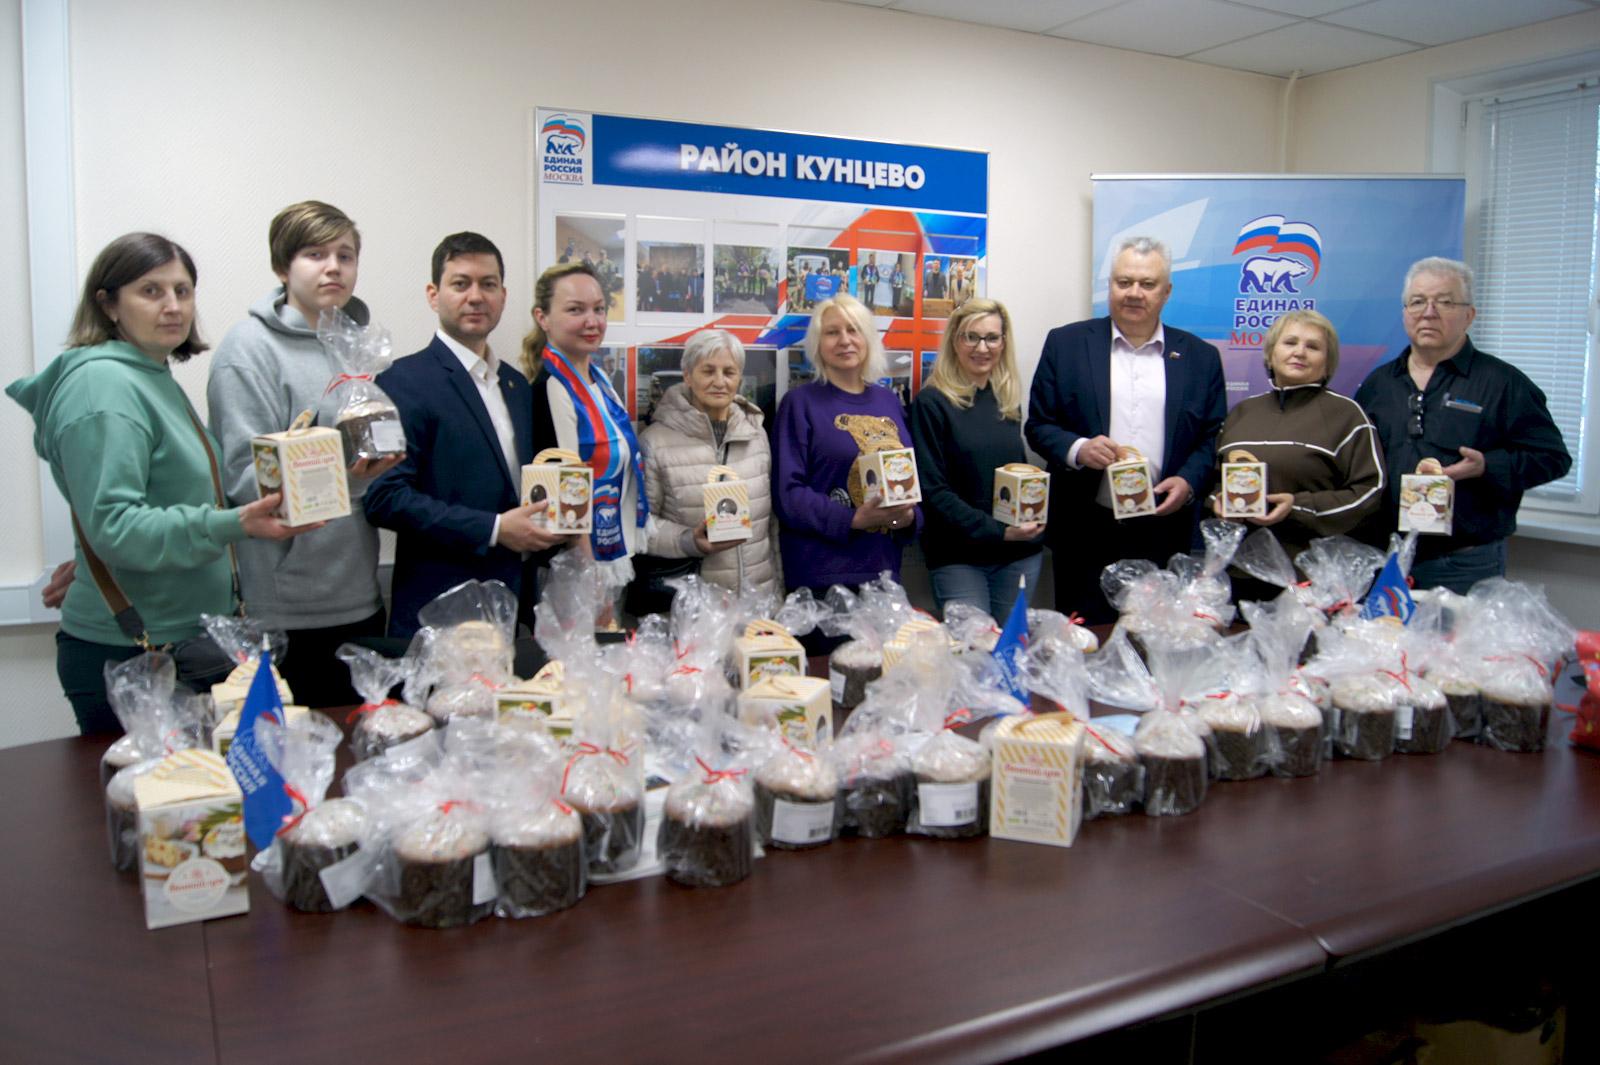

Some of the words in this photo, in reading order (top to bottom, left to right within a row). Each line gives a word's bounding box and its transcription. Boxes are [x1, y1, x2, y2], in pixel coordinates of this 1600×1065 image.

[544, 156, 582, 165] ЕДИНАЯ
[544, 164, 582, 174] РОССИЯ
[680, 142, 787, 177] РАЙОН
[797, 154, 926, 190] КУНЦЕВО
[543, 173, 583, 182] МОСКВА
[1236, 300, 1314, 312] ЕДИНАЯ
